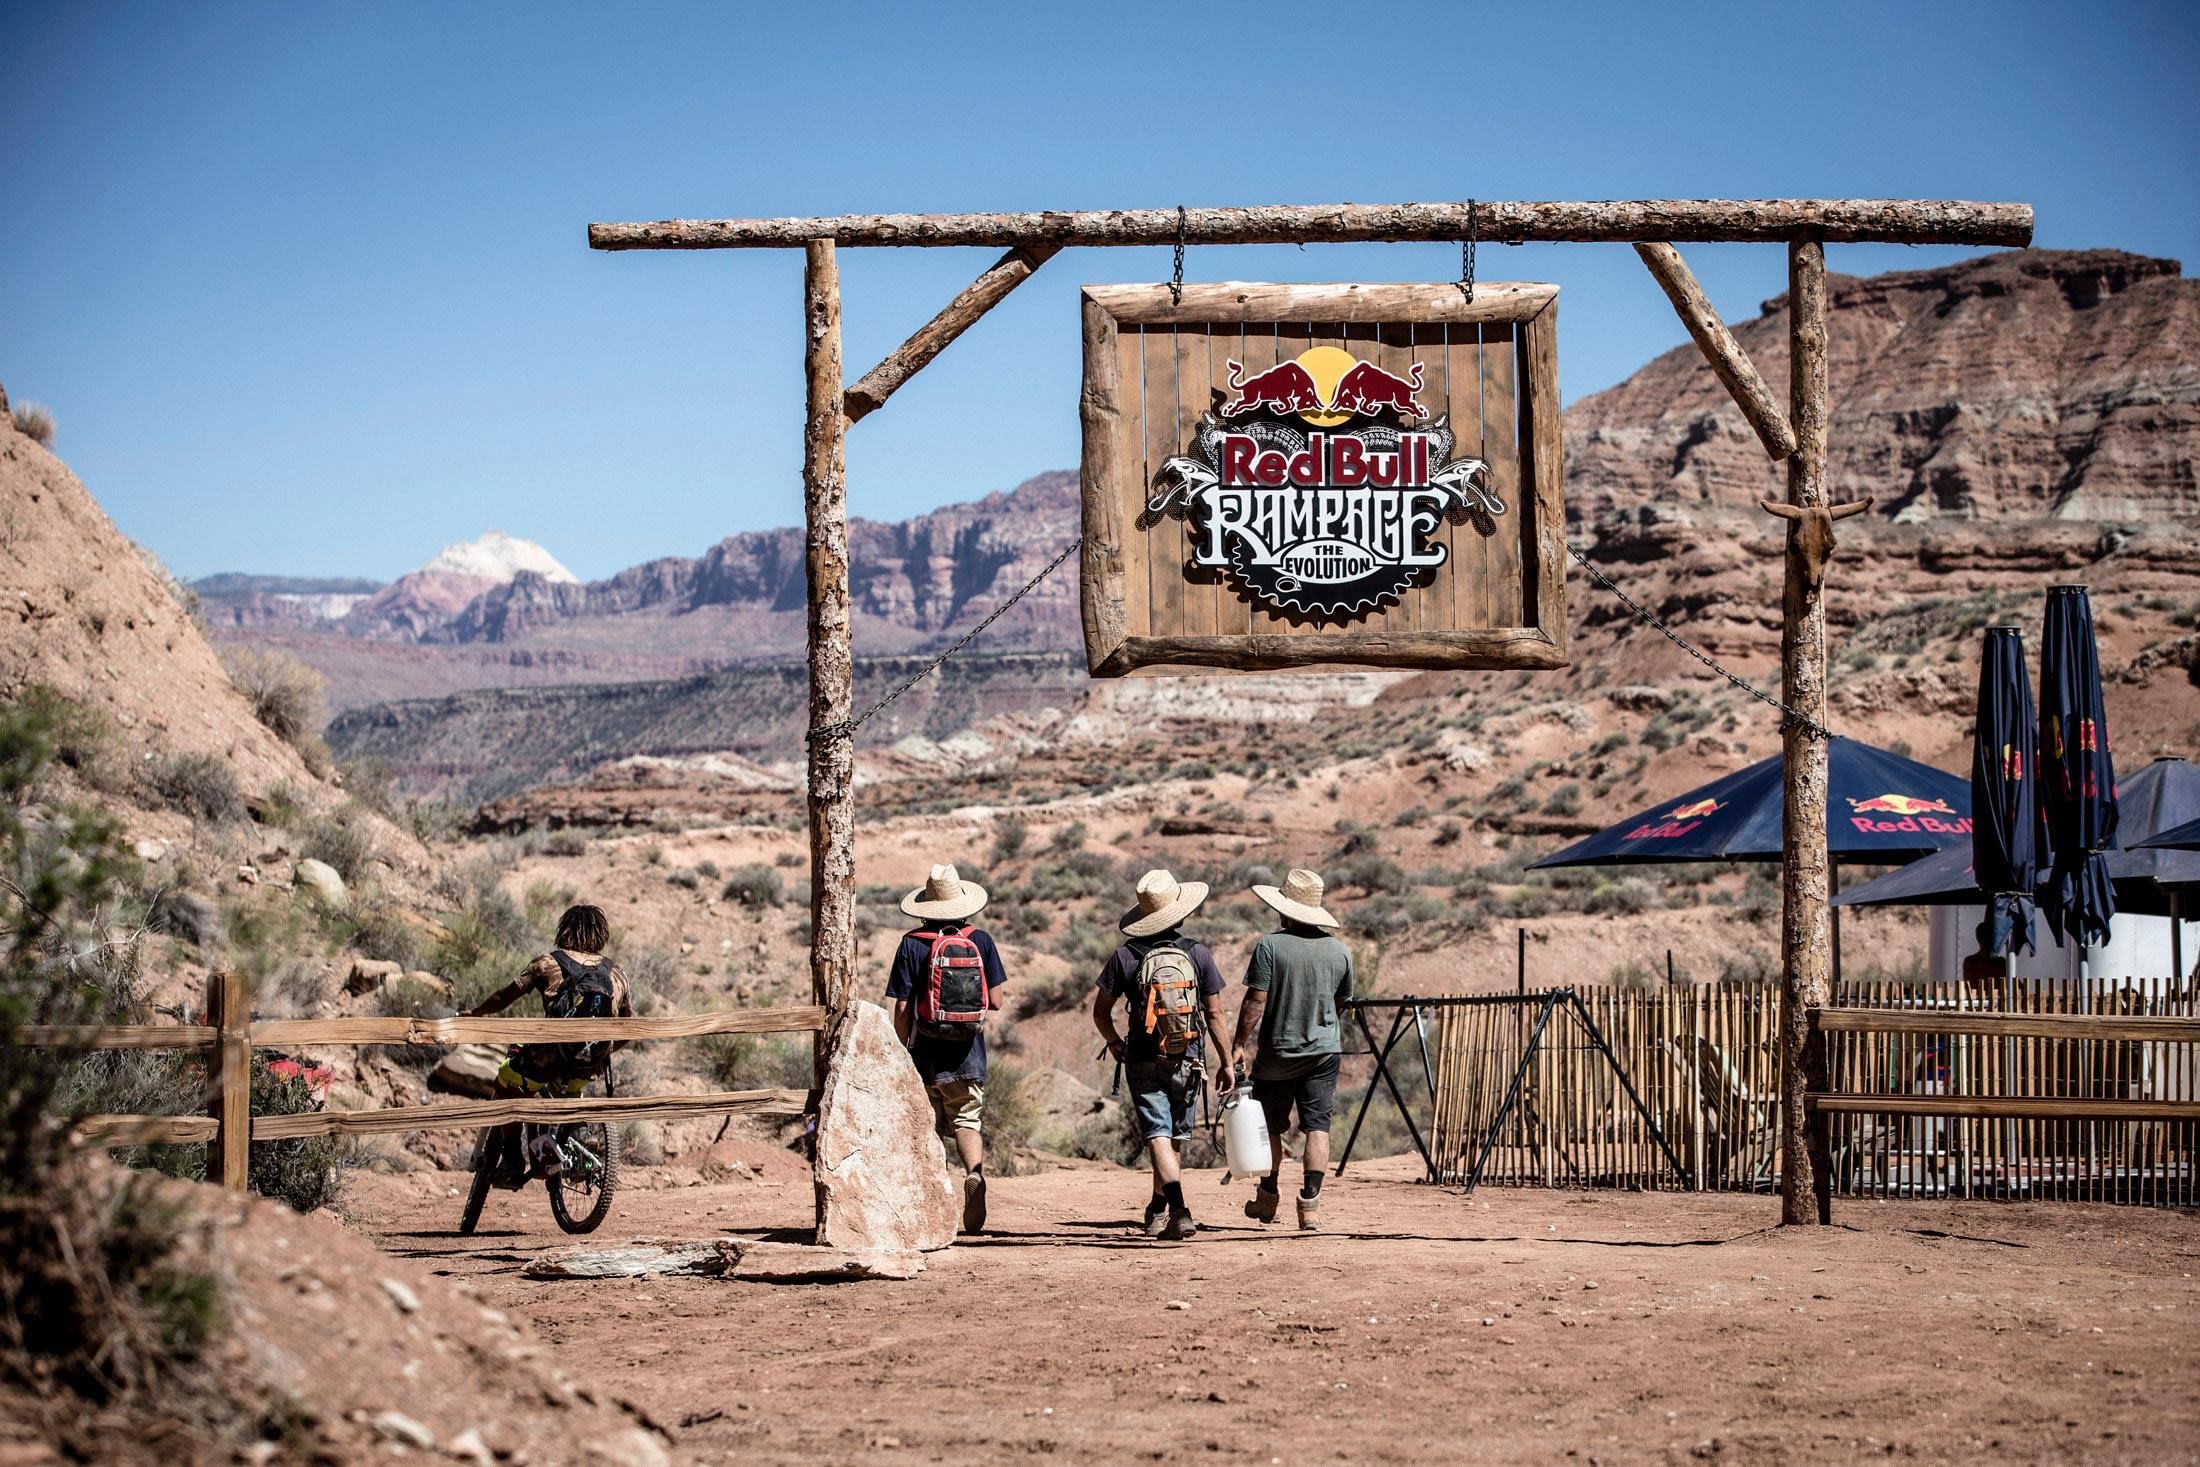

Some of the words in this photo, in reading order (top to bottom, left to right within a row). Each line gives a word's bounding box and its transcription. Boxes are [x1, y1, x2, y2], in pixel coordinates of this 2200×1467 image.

[1221, 431, 1325, 487] Red
[1329, 433, 1429, 488] Bull
[1197, 487, 1449, 566] RAMPAGE
[1313, 545, 1344, 556] THE
[1282, 557, 1373, 580] EVOLUTION
[1851, 816, 1922, 833] Red
